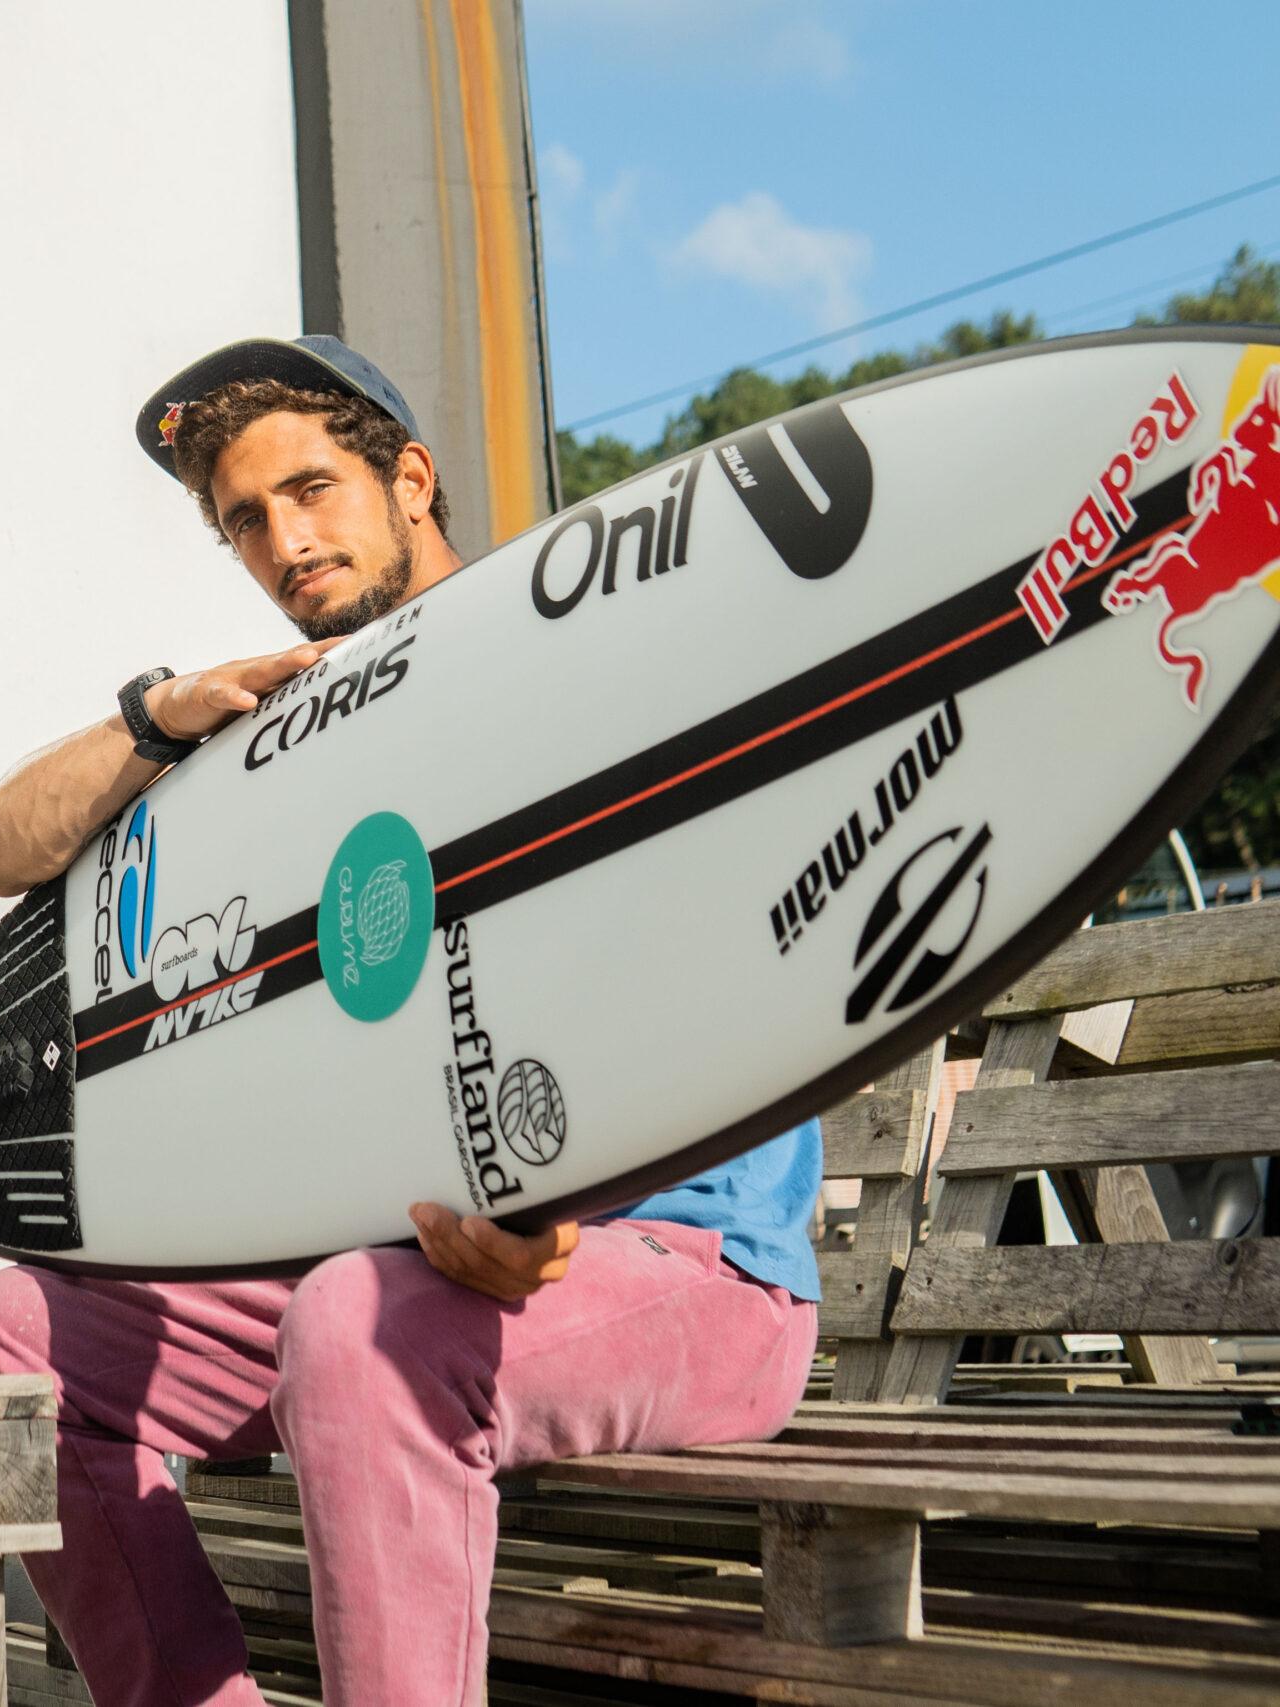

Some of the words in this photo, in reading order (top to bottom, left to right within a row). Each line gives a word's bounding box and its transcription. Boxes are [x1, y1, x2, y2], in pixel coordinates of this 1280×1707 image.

[1099, 374, 1198, 530] Red
[531, 452, 707, 620] Onil
[1020, 494, 1118, 638] Bull
[244, 634, 417, 771] CORIS
[252, 662, 329, 719] SEGURO
[769, 695, 963, 957] mormaii
[160, 947, 199, 972] surfboards
[443, 916, 524, 1209] surfland
[453, 1124, 484, 1213] GAROPABA
